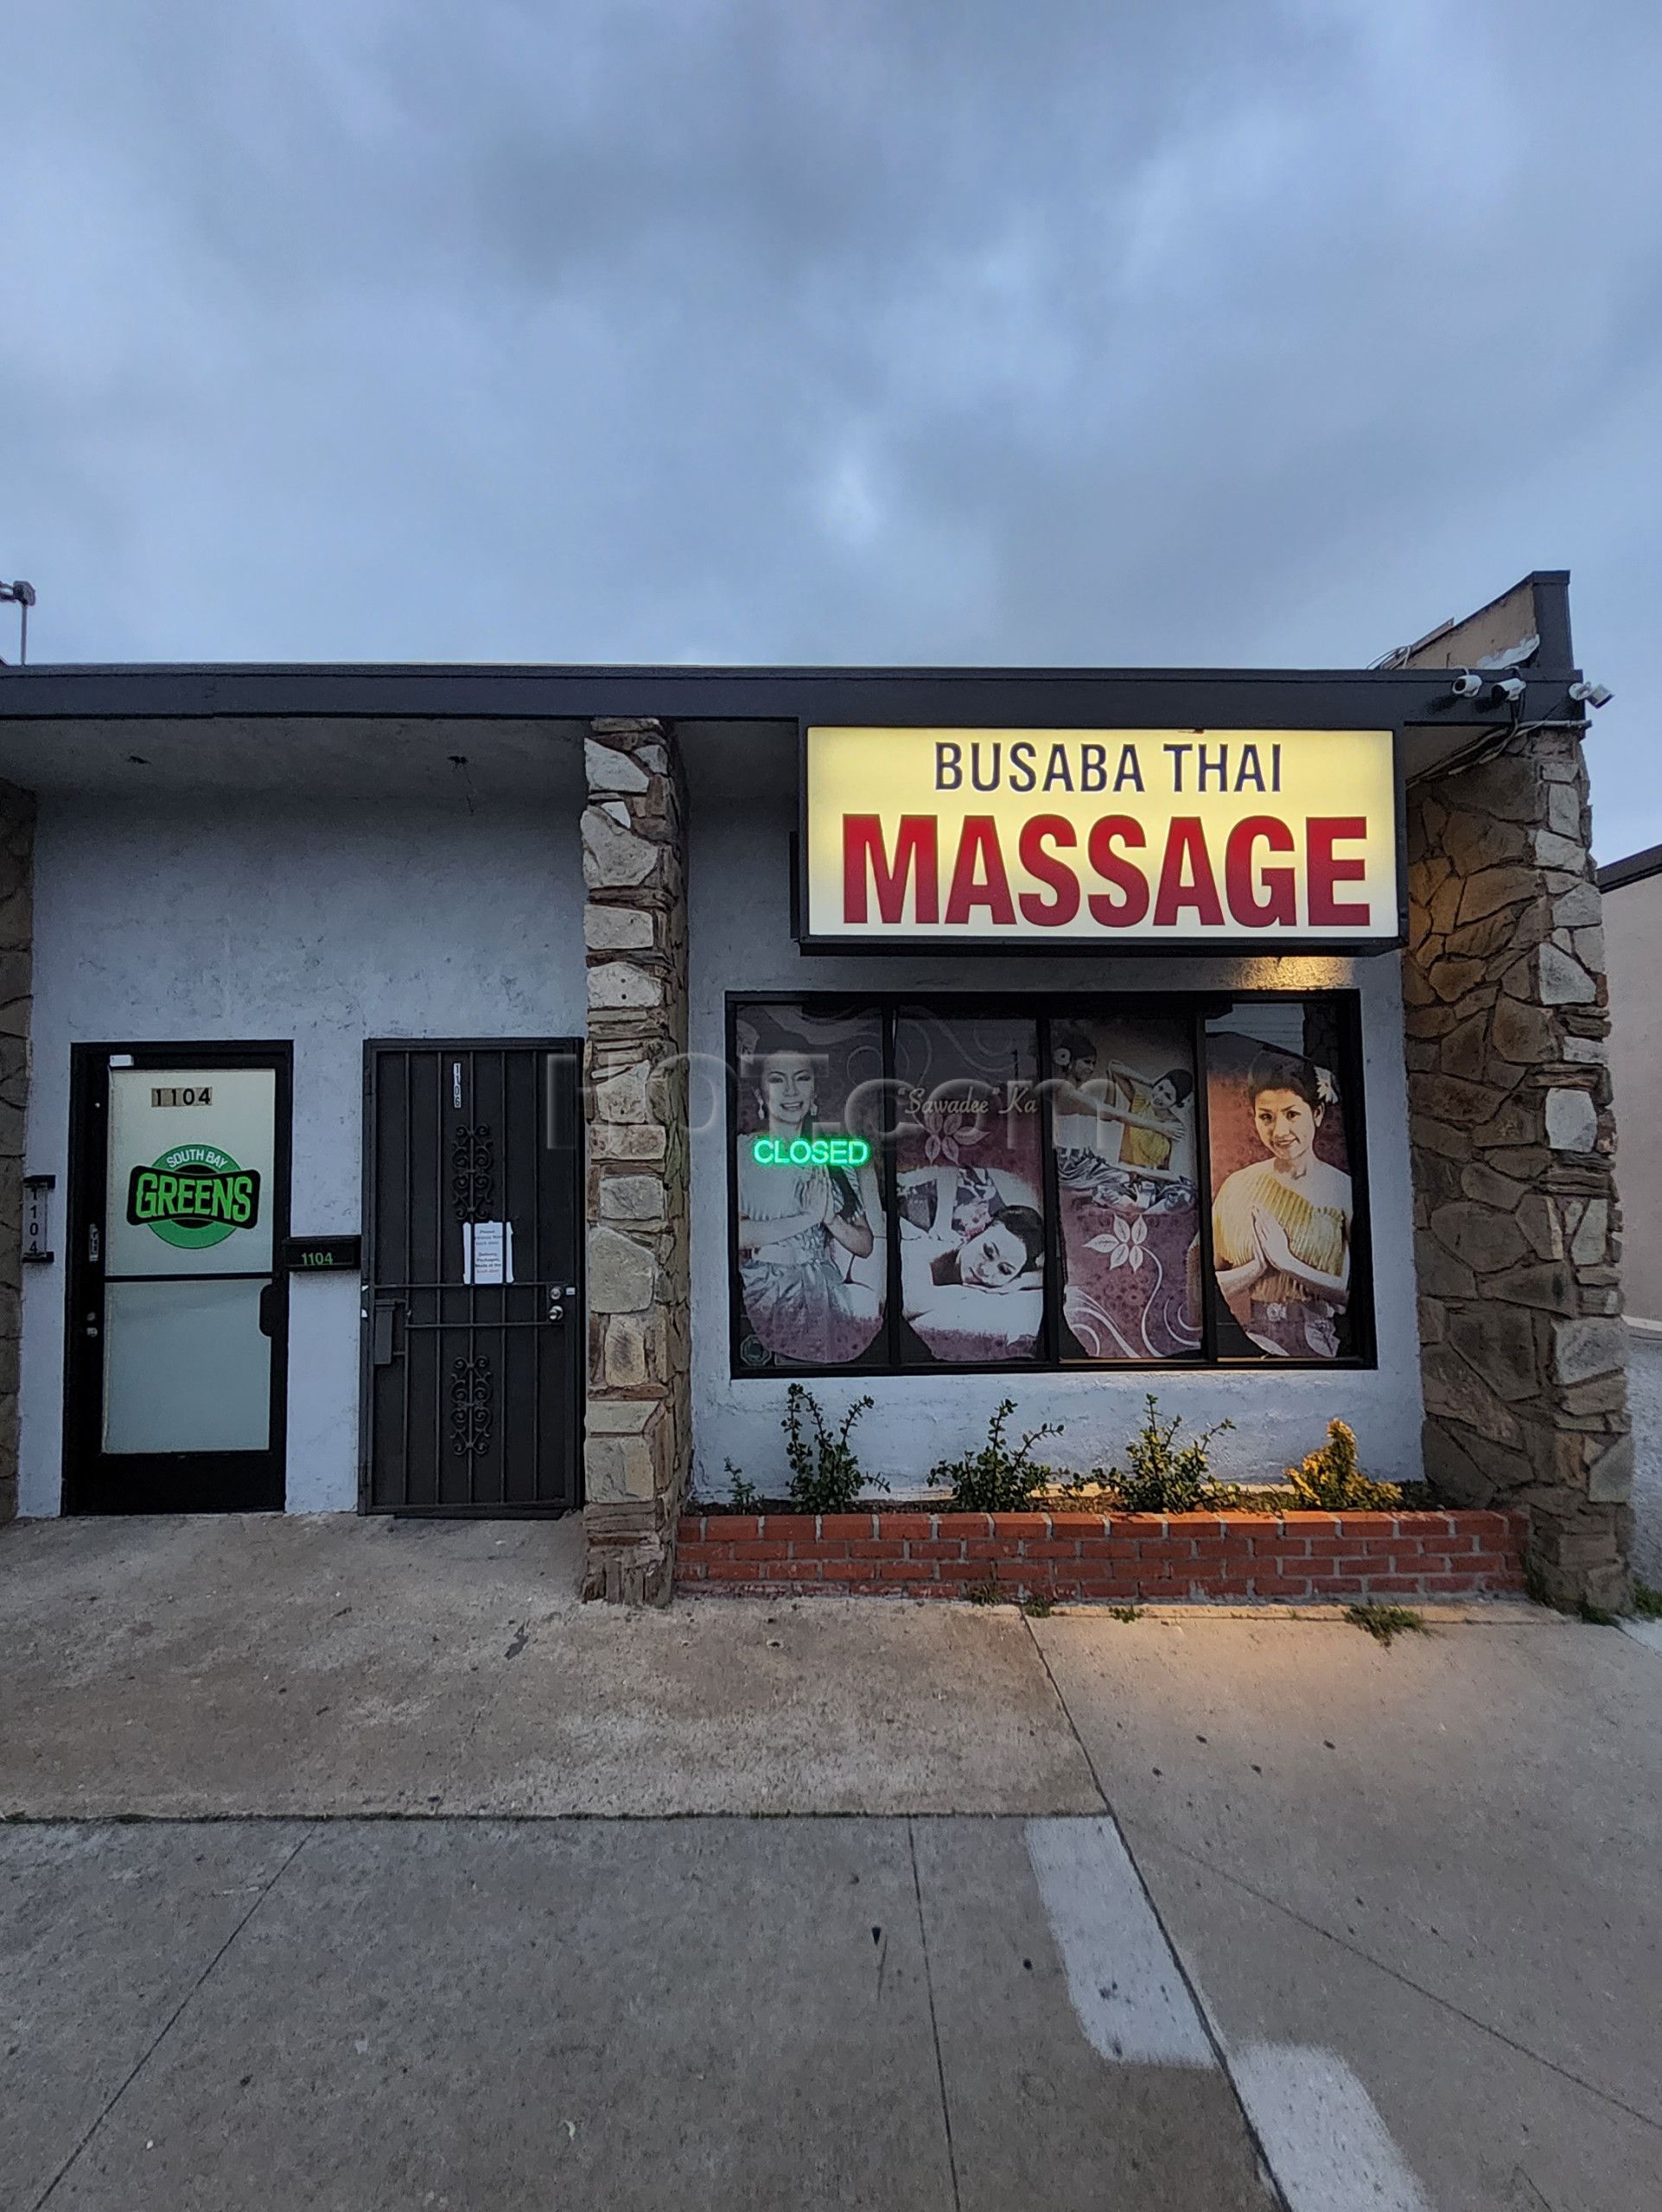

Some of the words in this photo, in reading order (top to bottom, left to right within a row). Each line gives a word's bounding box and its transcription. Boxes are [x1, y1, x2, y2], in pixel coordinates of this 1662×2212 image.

[934, 742, 1146, 792] BUSABA
[1163, 743, 1282, 792] THAI
[842, 814, 1372, 928] MASSAGE
[155, 1087, 211, 1107] 1104
[999, 1086, 1037, 1115] Ka
[165, 1148, 205, 1168] SOUTH
[205, 1151, 229, 1169] BAY
[754, 1139, 869, 1165] CLOSED
[135, 1172, 253, 1223] GREENS
[301, 1252, 334, 1266] 1104
